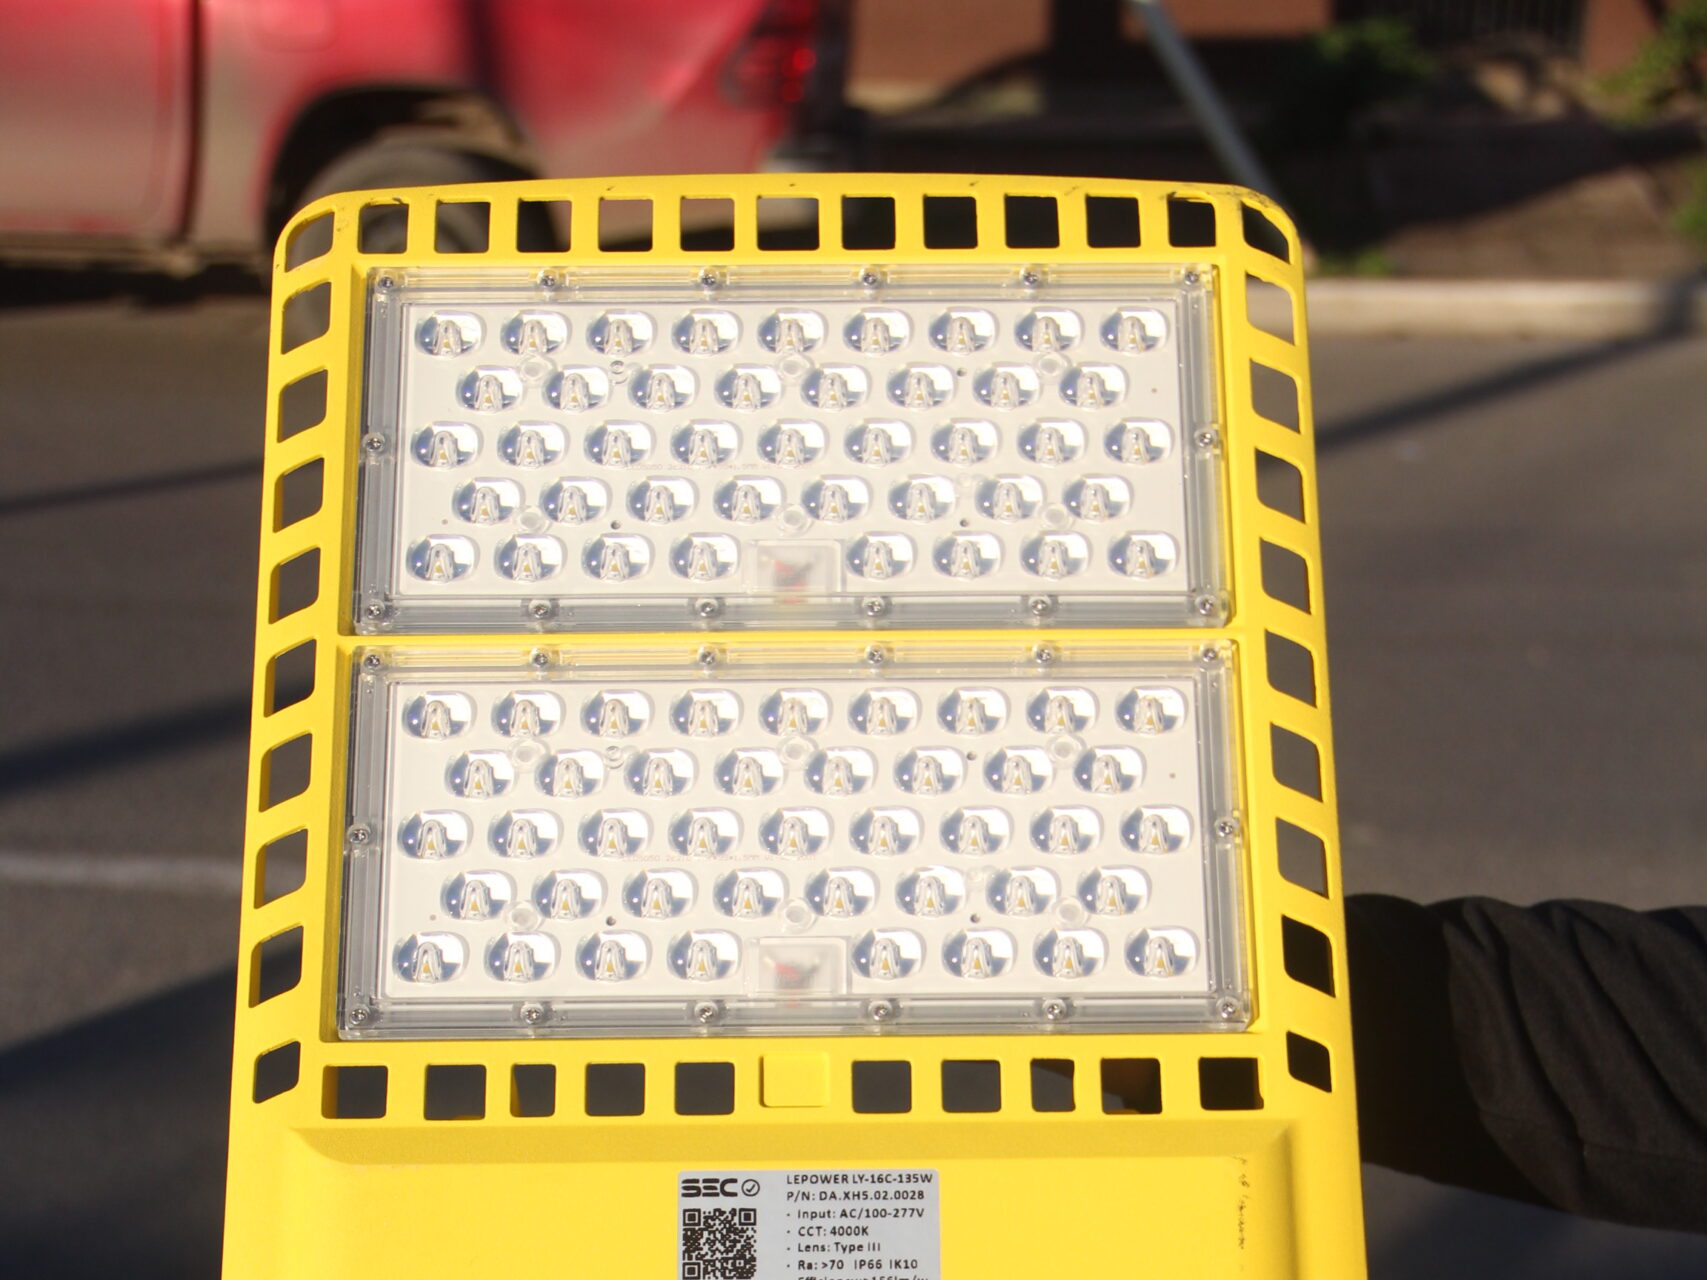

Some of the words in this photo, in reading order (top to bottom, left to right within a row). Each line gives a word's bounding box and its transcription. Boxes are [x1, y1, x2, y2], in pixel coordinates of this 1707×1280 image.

[787, 1174, 849, 1184] LEPOWER
[853, 1174, 933, 1183] LY-16C-135W
[681, 1178, 738, 1198] SEC
[787, 1191, 816, 1202] P/N:
[819, 1190, 925, 1201] DA.XH5.02.0028
[798, 1210, 836, 1220] Input:
[840, 1208, 925, 1219] AC/100-277V
[798, 1226, 827, 1236] CCT:
[830, 1226, 869, 1236] 4000K
[798, 1243, 830, 1252] Lens:
[834, 1242, 864, 1254] Type
[867, 1242, 881, 1252] III
[798, 1260, 818, 1270] Ra:
[822, 1260, 845, 1270] >70
[855, 1259, 883, 1269] IP66
[890, 1259, 918, 1269] IK10
